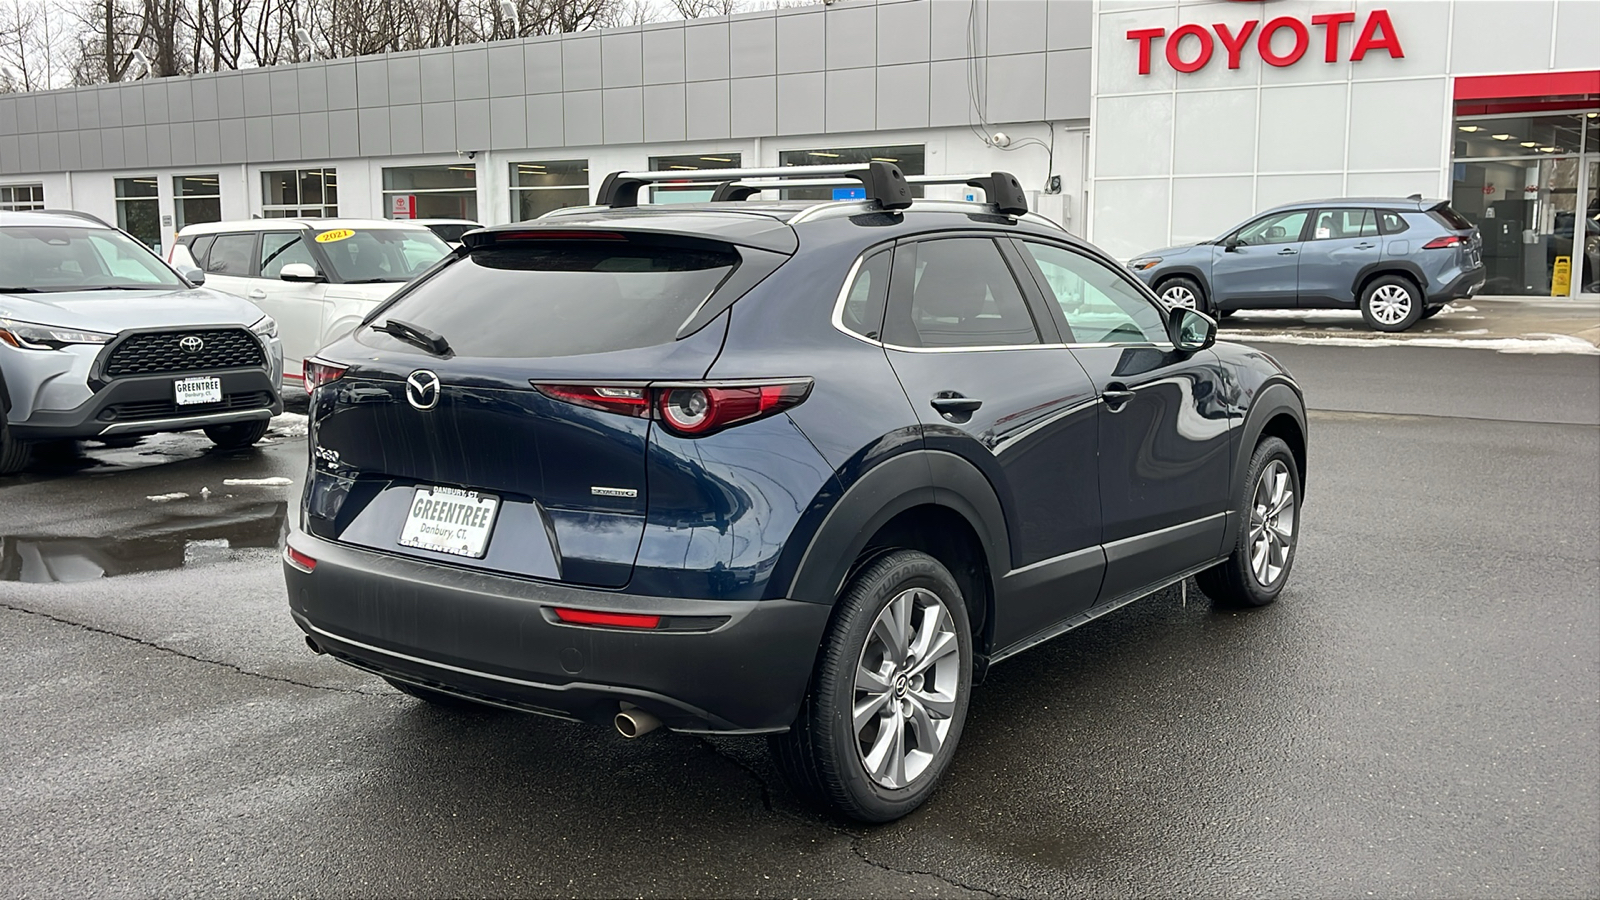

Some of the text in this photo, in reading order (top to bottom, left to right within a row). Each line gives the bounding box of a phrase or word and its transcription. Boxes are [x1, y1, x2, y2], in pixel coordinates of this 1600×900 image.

[1127, 9, 1405, 76] TOYOTA
[323, 230, 348, 241] 2021
[177, 381, 219, 392] GREENTREE
[433, 486, 467, 498] DANBURY,
[413, 498, 490, 528] GREENTREE
[420, 523, 467, 540] Danbury, CT.
[874, 563, 936, 600] TURANZA
